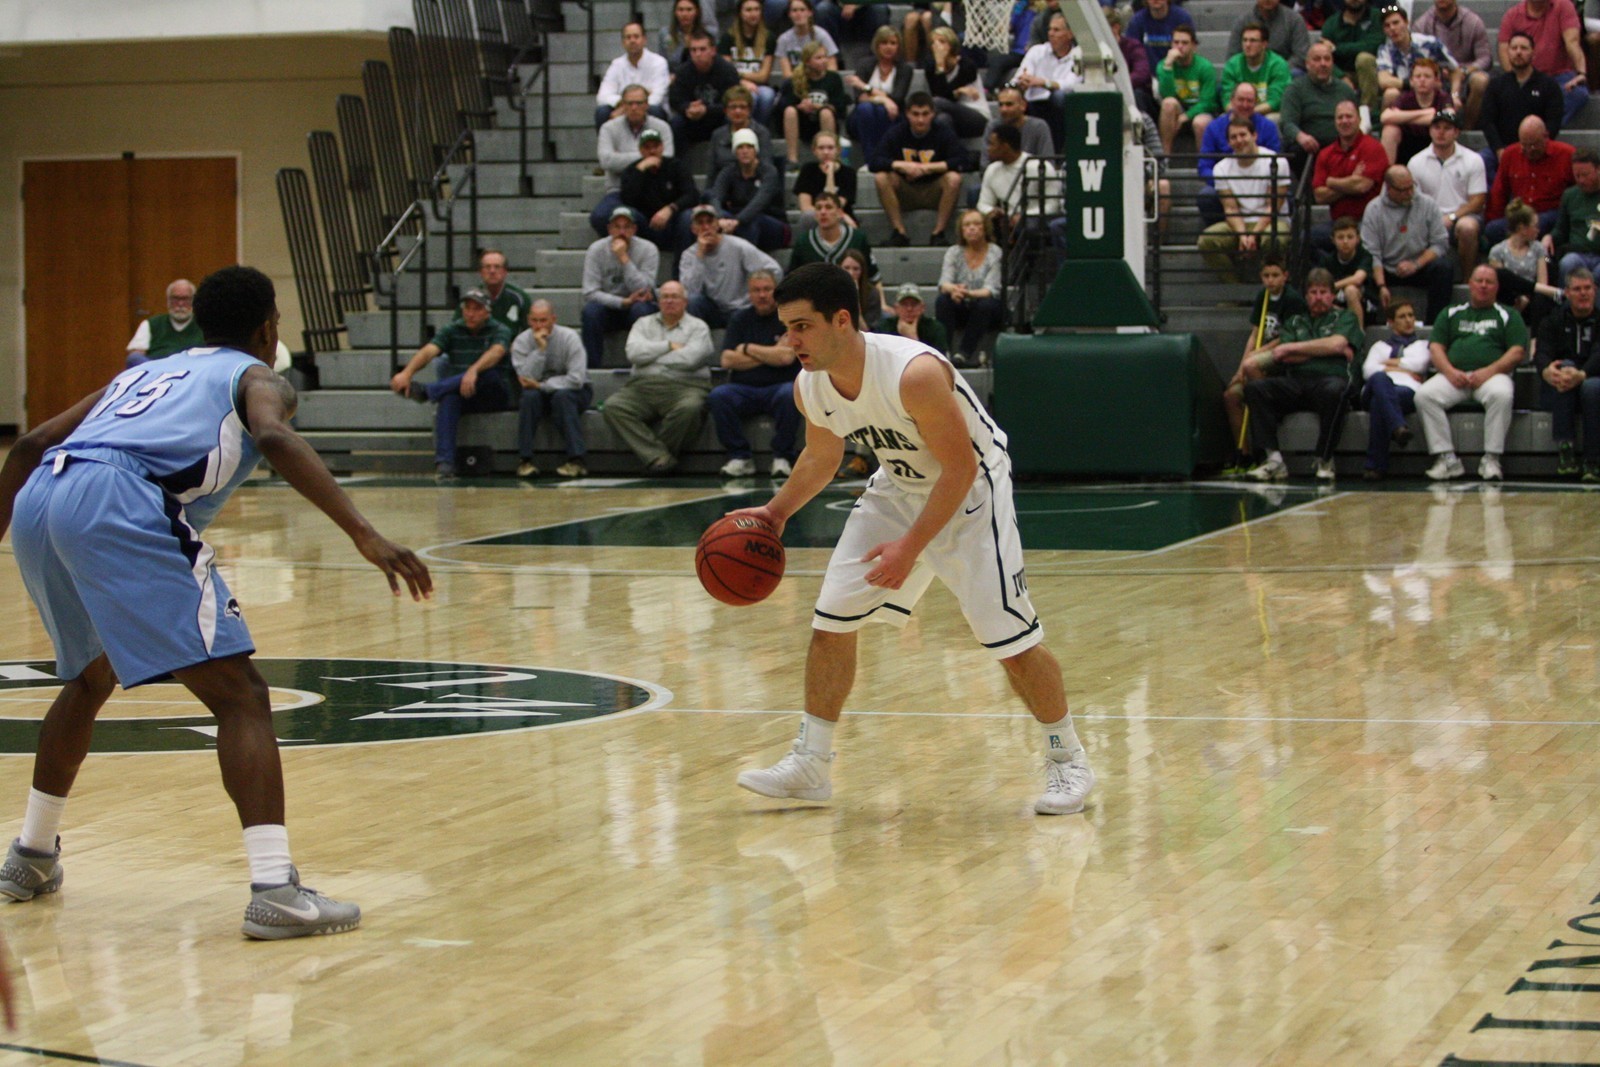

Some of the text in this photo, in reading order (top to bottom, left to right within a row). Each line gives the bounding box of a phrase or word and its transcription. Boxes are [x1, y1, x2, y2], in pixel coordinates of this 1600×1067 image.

[1078, 112, 1106, 240] IWU
[90, 370, 191, 418] 15
[744, 540, 782, 562] NCAA
